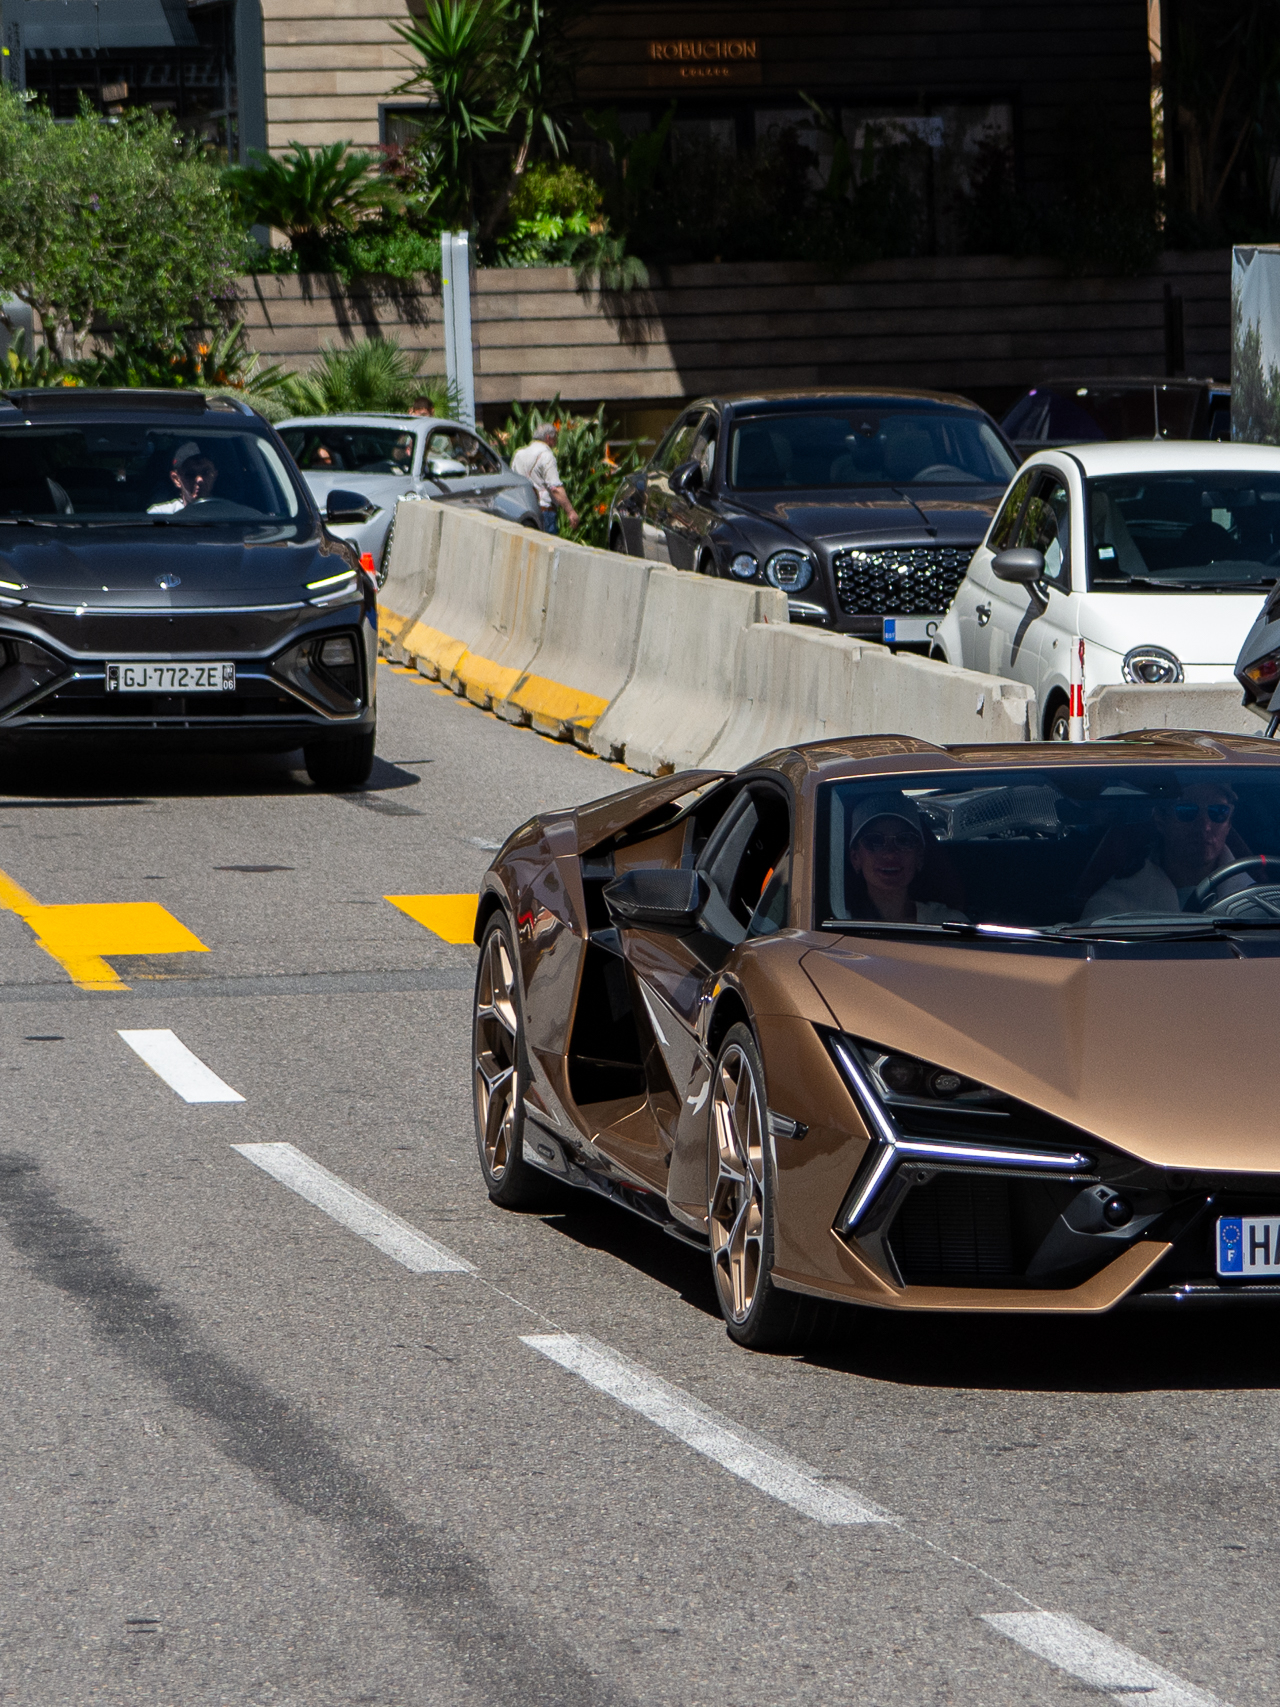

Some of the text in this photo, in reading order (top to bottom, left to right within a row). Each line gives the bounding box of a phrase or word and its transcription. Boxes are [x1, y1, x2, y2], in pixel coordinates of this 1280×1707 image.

[650, 41, 756, 60] ROBUCHON
[124, 667, 218, 687] GJ-772-ZE
[223, 680, 234, 690] 06
[1227, 1250, 1235, 1262] F
